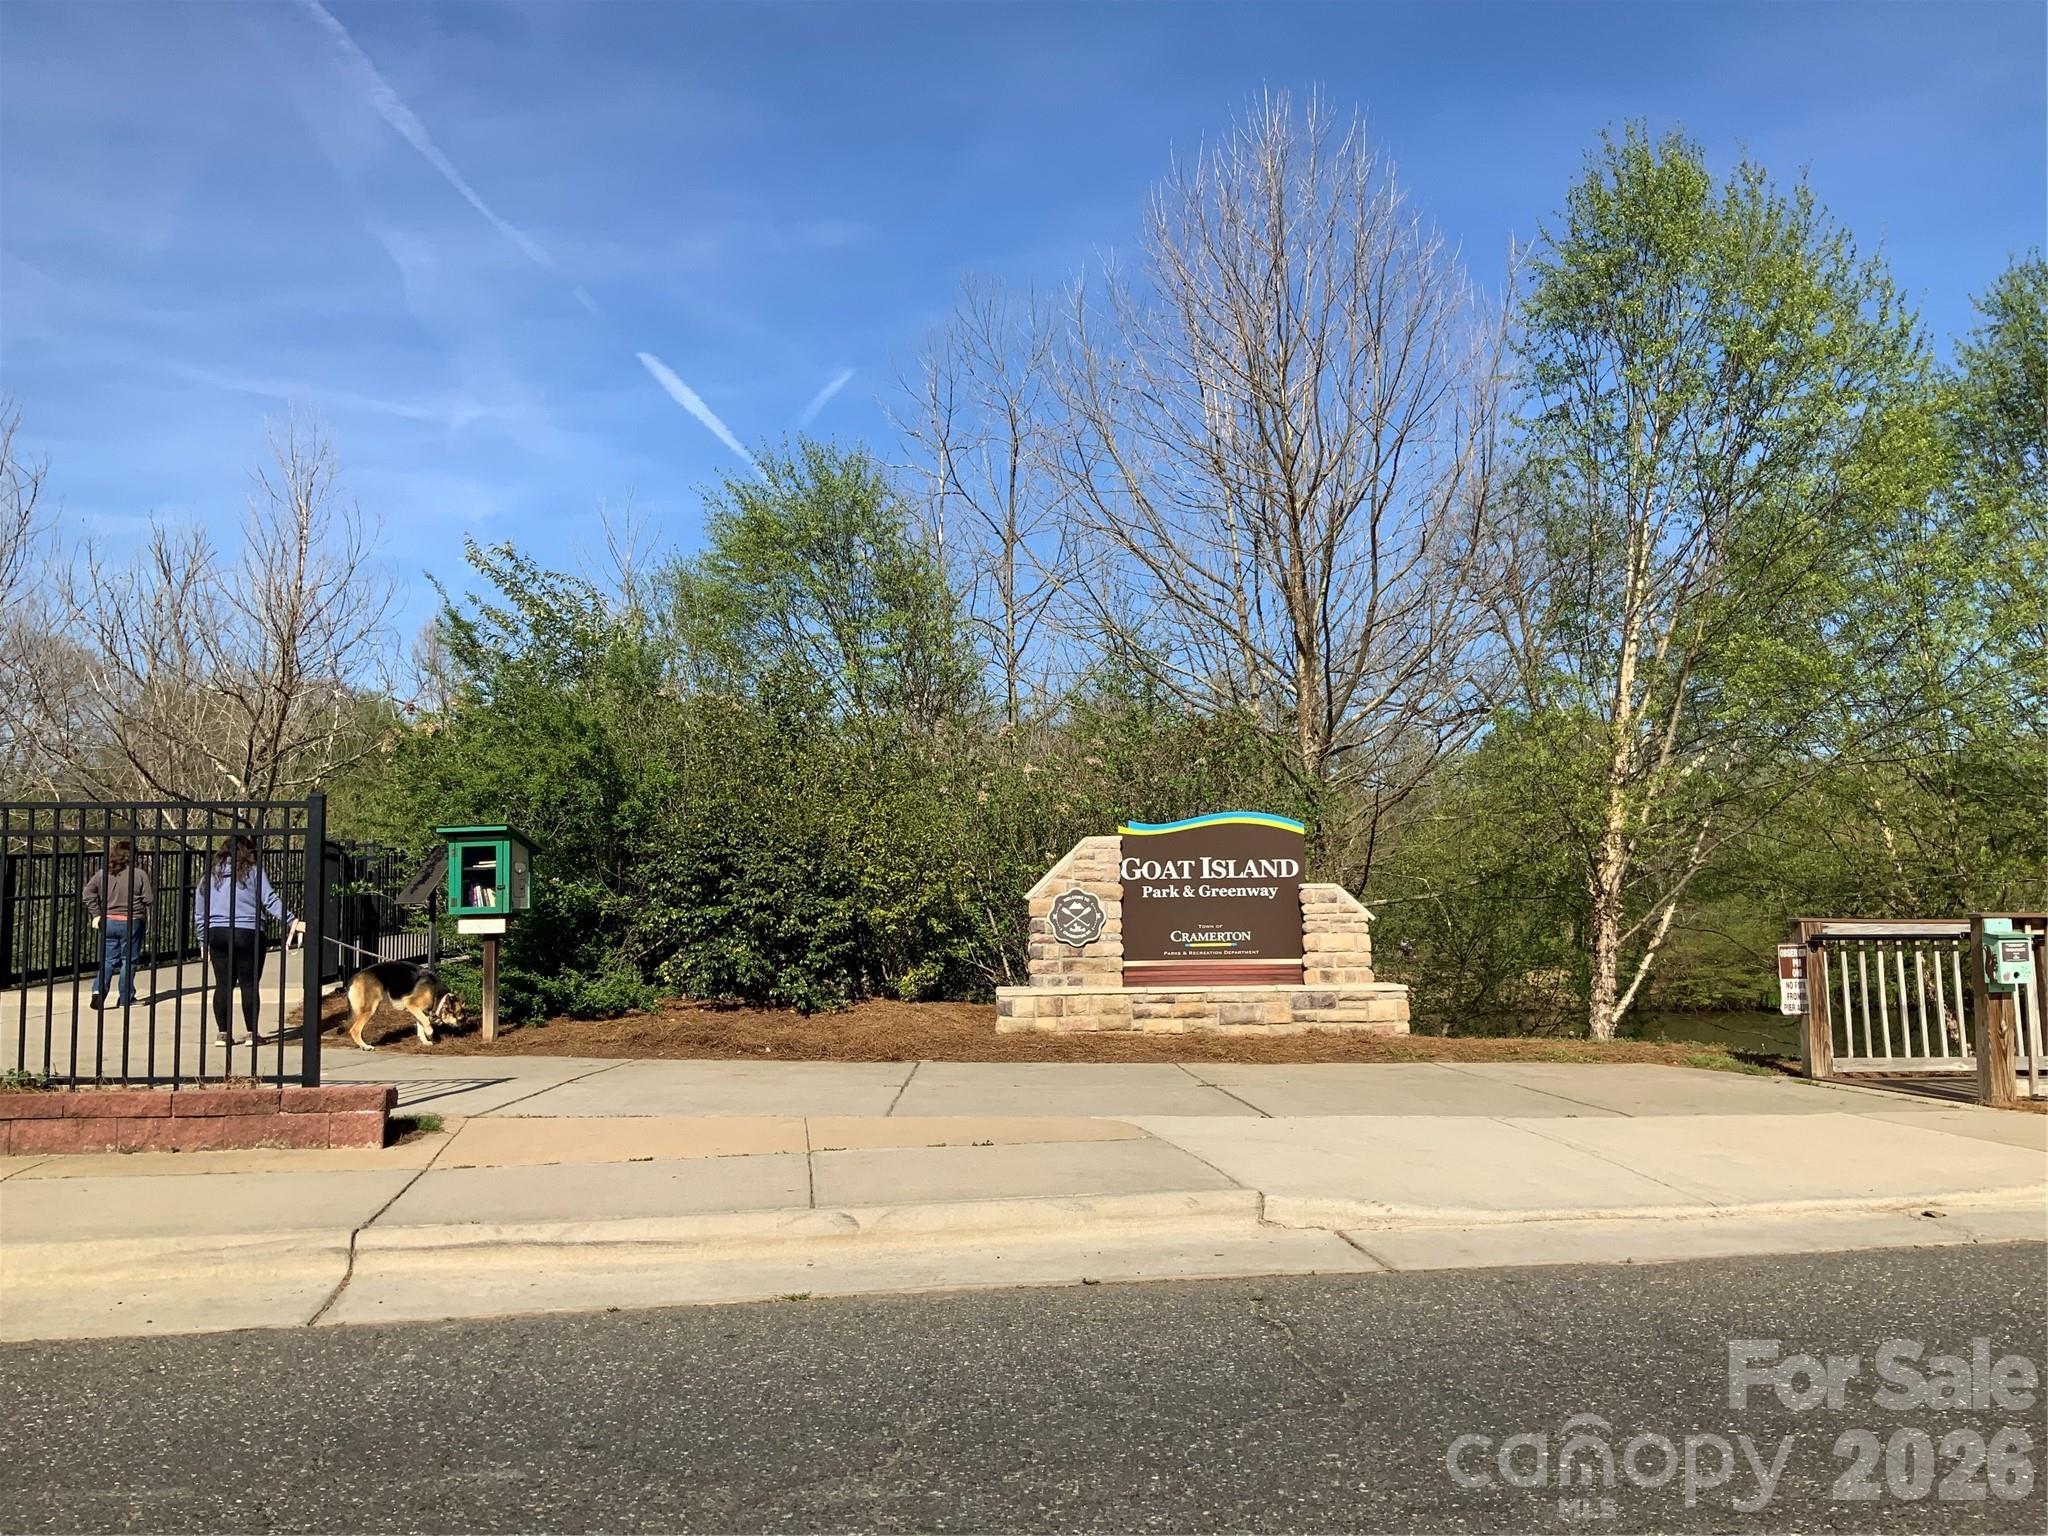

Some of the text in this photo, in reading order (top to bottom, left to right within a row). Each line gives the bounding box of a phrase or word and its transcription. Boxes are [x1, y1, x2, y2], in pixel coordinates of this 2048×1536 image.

[1121, 857, 1299, 880] GOAT ISLAND
[1142, 885, 1278, 899] Park & Greenway
[1170, 930, 1251, 942] CRAMERTON
